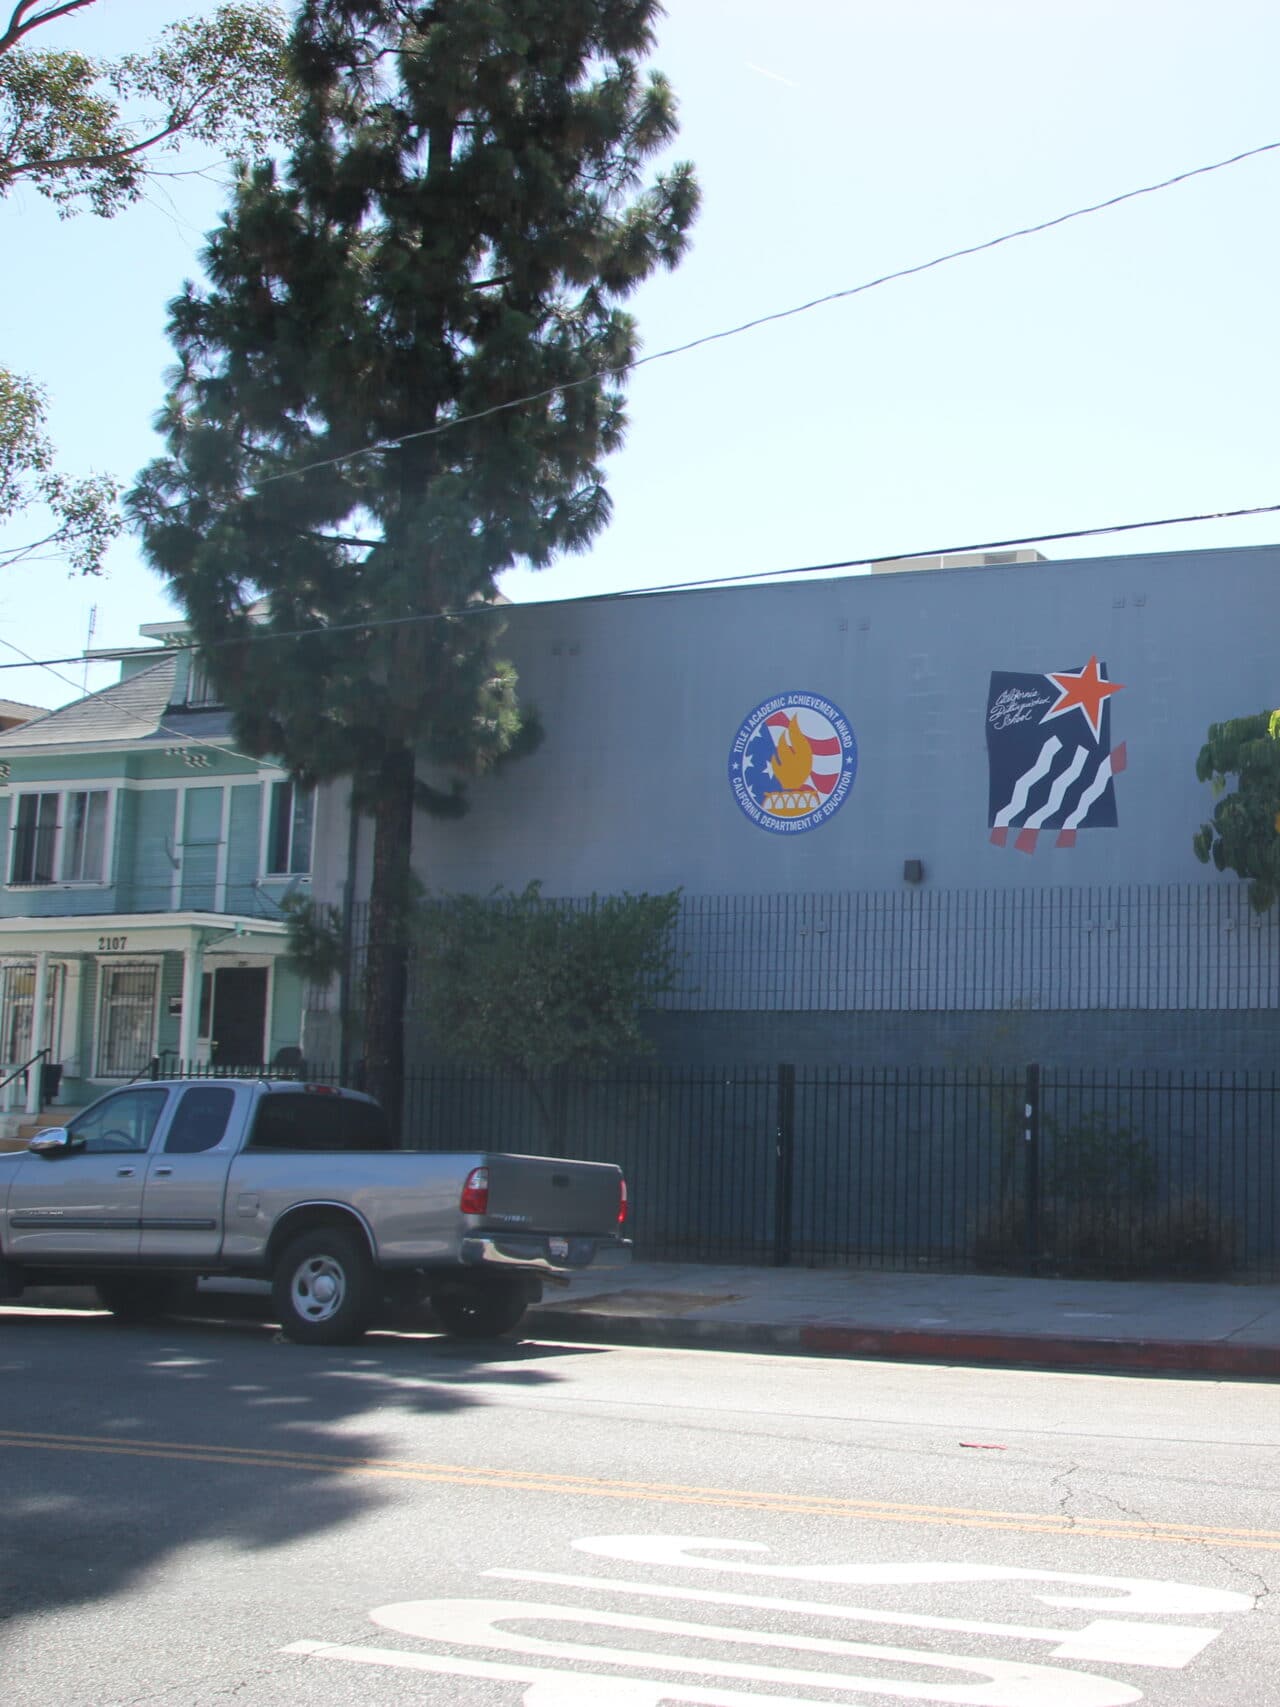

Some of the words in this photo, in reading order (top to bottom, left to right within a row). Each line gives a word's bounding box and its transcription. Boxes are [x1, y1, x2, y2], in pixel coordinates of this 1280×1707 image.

[995, 688, 1039, 705] California
[734, 731, 749, 754] TITLE
[750, 697, 786, 727] ACADEMIC
[788, 695, 839, 721] ACHIEVEMENT
[834, 718, 853, 749] AWARD
[993, 709, 1033, 730] School
[733, 777, 760, 822] CALIFORNIA
[760, 817, 811, 832] DEPARTMENT
[814, 811, 823, 824] OF
[823, 771, 853, 816] EDUCATION
[98, 936, 128, 950] 2107
